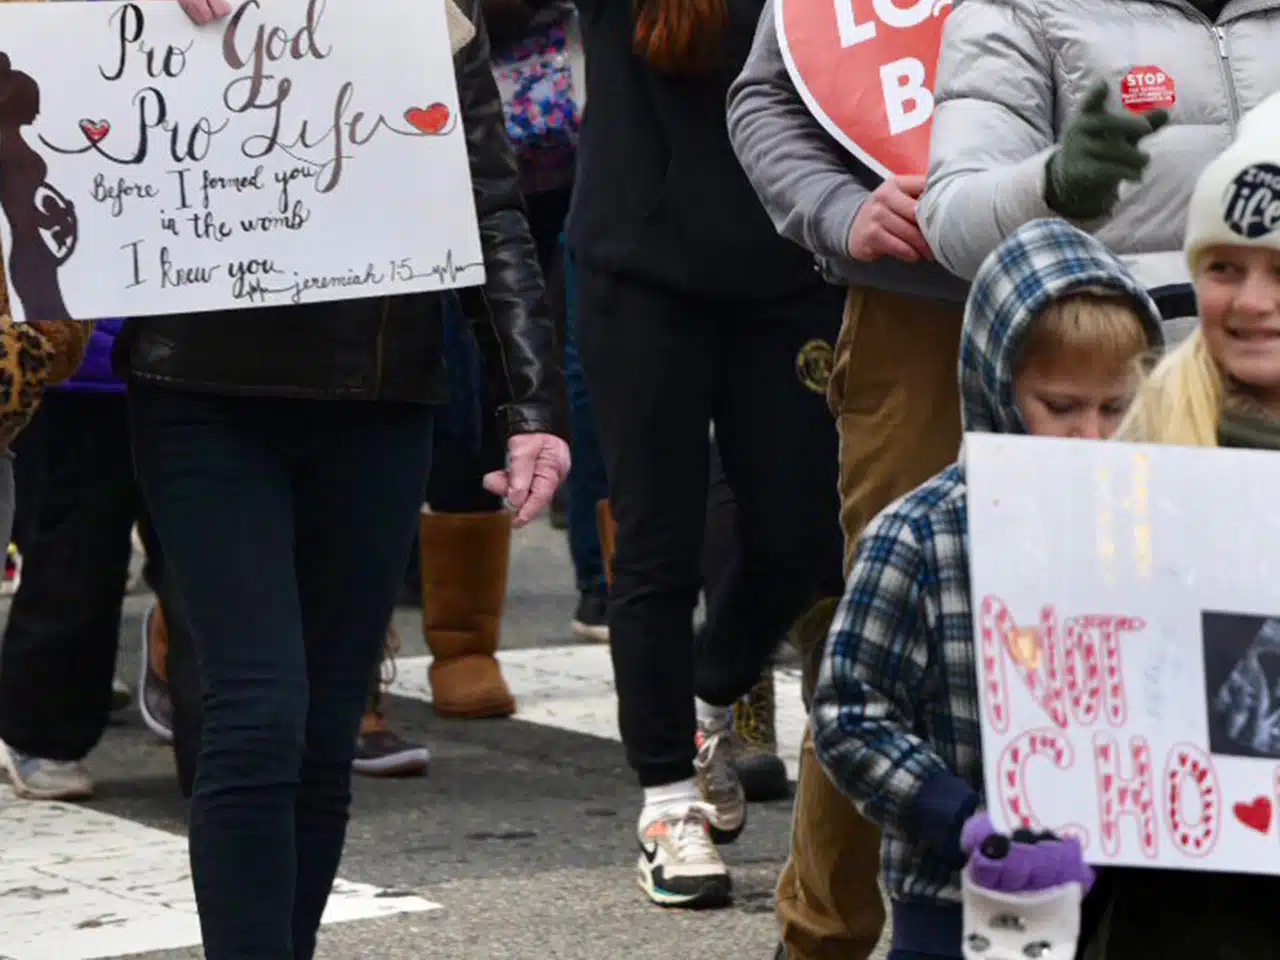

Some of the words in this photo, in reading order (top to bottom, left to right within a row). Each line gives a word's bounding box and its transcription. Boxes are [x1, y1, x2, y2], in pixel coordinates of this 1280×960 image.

[1126, 71, 1167, 88] STOP
[91, 172, 160, 218] Before
[165, 168, 193, 211] I
[199, 164, 265, 210] formed
[160, 208, 180, 237] in
[186, 210, 233, 242] the
[240, 199, 312, 232] womb
[119, 238, 149, 289] I
[979, 592, 1147, 734] NOT
